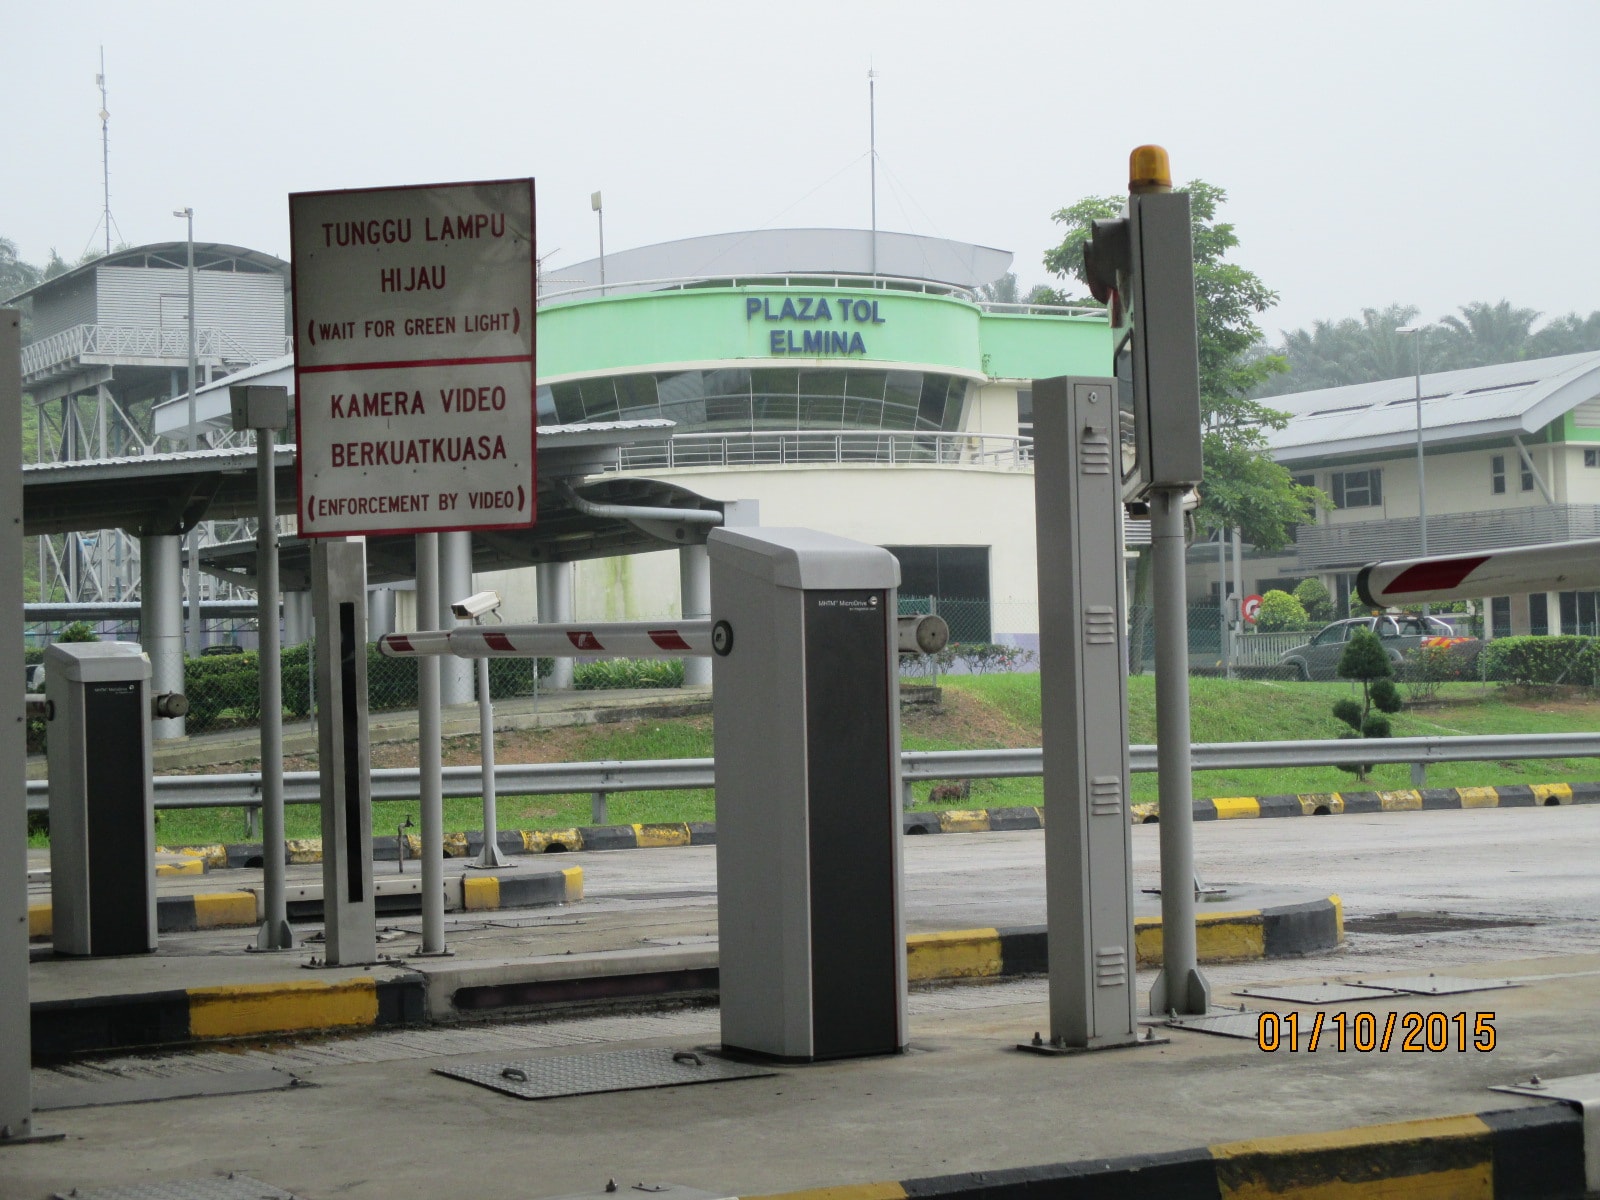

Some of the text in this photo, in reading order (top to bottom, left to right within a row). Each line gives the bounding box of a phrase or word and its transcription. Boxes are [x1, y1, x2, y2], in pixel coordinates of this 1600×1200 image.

[322, 213, 506, 247] TUNGGU LAMPU
[381, 265, 446, 292] HIJAU
[746, 298, 886, 323] PLAZA TOL
[365, 320, 395, 338] FOR
[405, 317, 456, 336] GREEN
[770, 330, 867, 354] ELMINA
[331, 385, 506, 419] KAMERA VIDEO
[332, 435, 507, 468] BERKUATKUASA
[439, 493, 458, 510] BY
